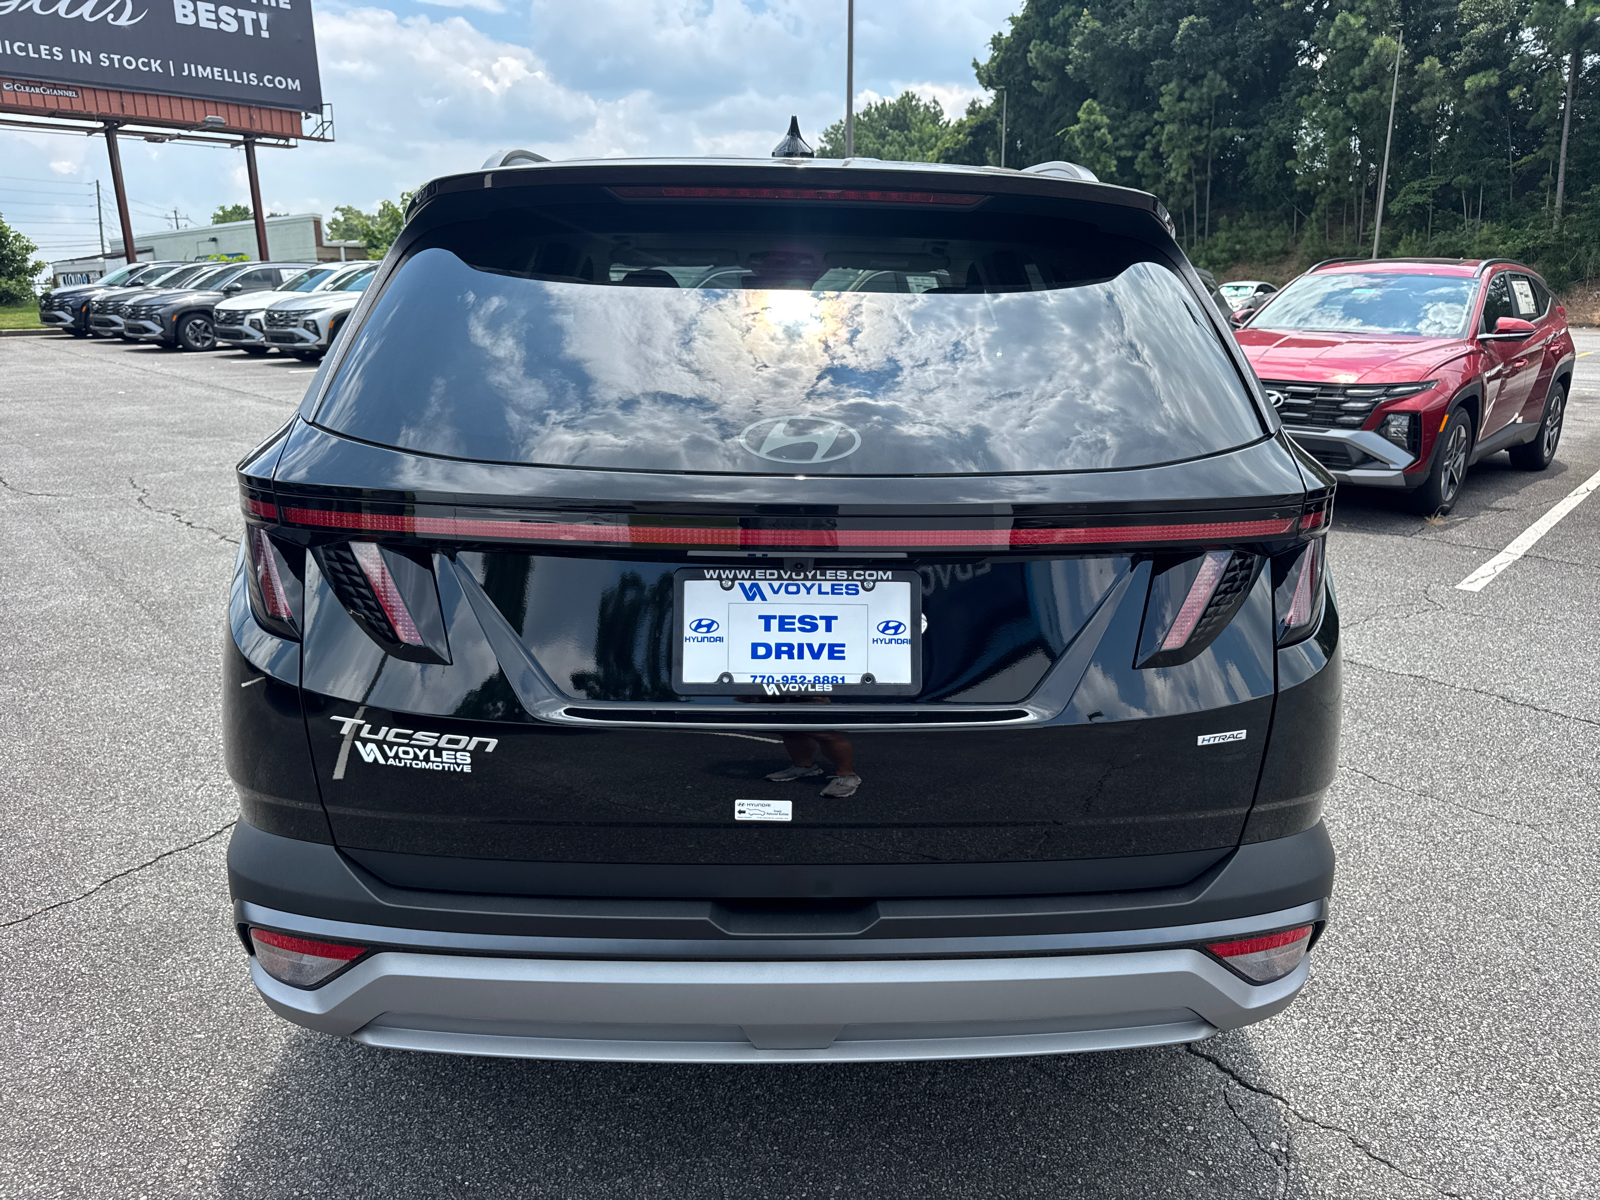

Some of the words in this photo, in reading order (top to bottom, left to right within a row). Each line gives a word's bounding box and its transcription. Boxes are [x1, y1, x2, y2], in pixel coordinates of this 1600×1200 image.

[173, 0, 270, 39] BEST!
[70, 48, 93, 65] IN
[99, 52, 164, 73] STOCK
[181, 62, 301, 92] JIMELLIS.COM
[768, 582, 861, 596] VOYLES
[758, 614, 839, 633] TEST
[872, 637, 911, 645] HYUNDAI
[751, 642, 846, 661] DRIVE
[750, 675, 846, 684] 770-952-8881
[780, 683, 833, 692] VOYLES
[1201, 732, 1243, 744] HTRAC
[382, 744, 472, 764] VOYLES
[386, 758, 472, 773] AUTOMOTIVE
